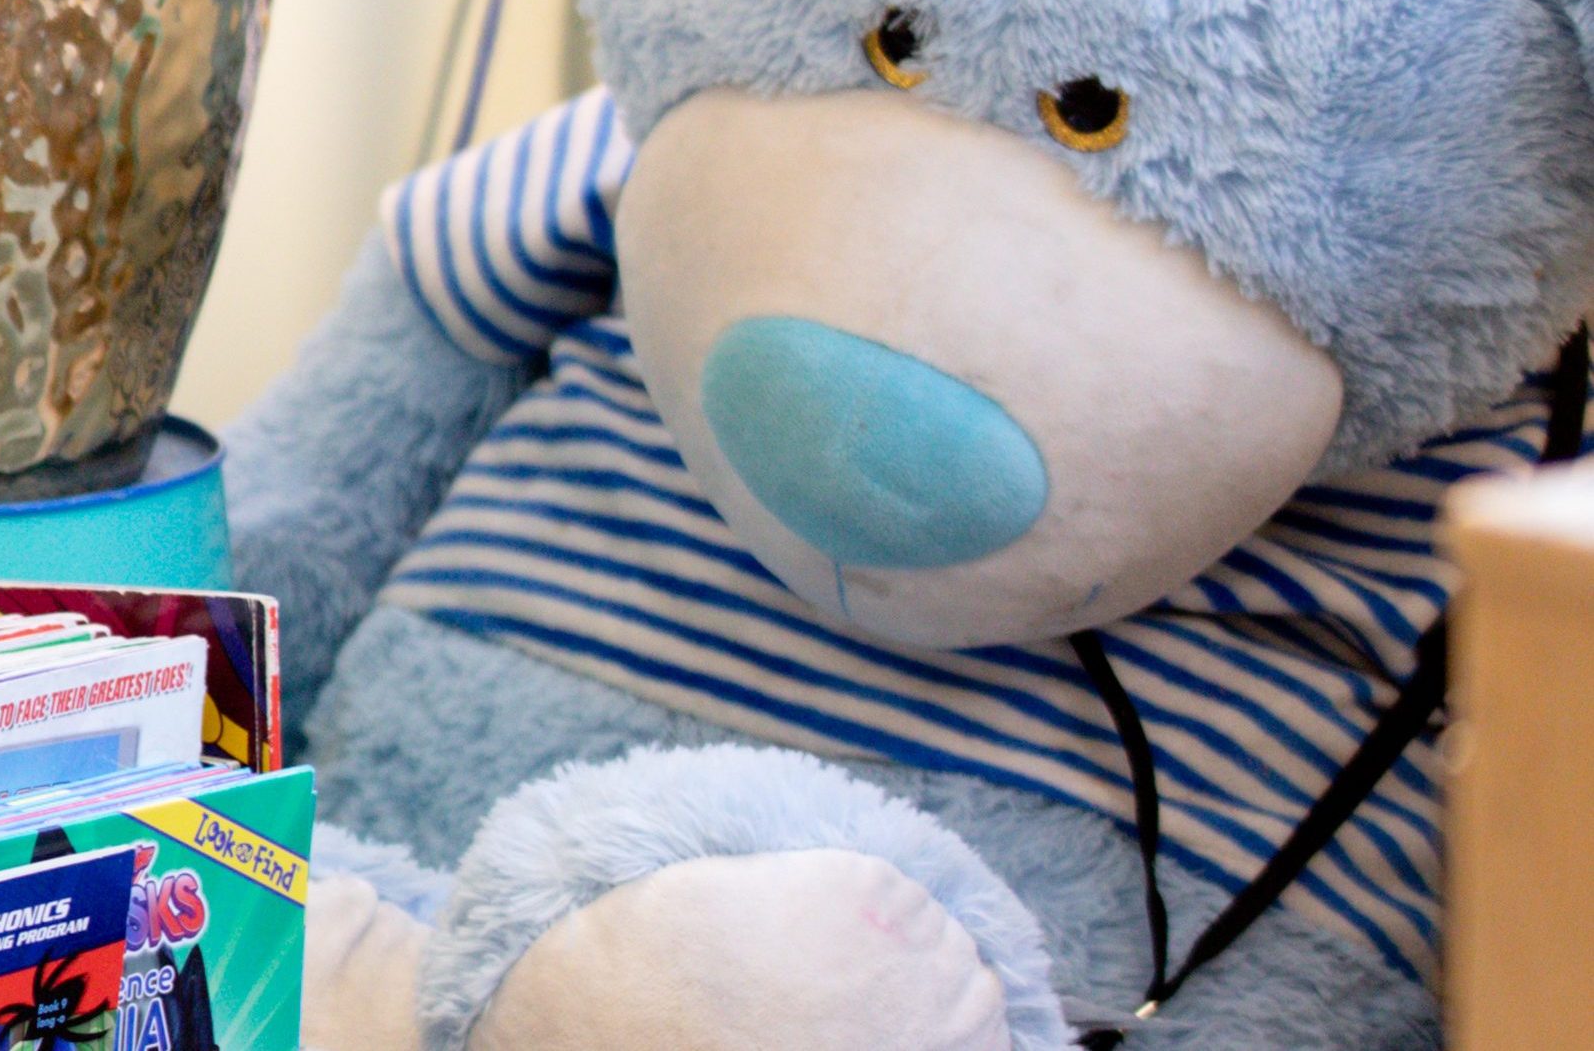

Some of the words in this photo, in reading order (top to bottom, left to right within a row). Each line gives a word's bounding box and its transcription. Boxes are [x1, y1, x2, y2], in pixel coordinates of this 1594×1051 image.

[16, 698, 48, 724] FACE
[50, 685, 88, 716] THEIR
[89, 672, 152, 708] GREATEST
[194, 812, 235, 859] Look
[16, 916, 90, 947] PROGRAM
[38, 1001, 59, 1016] Book
[61, 998, 68, 1010] 9
